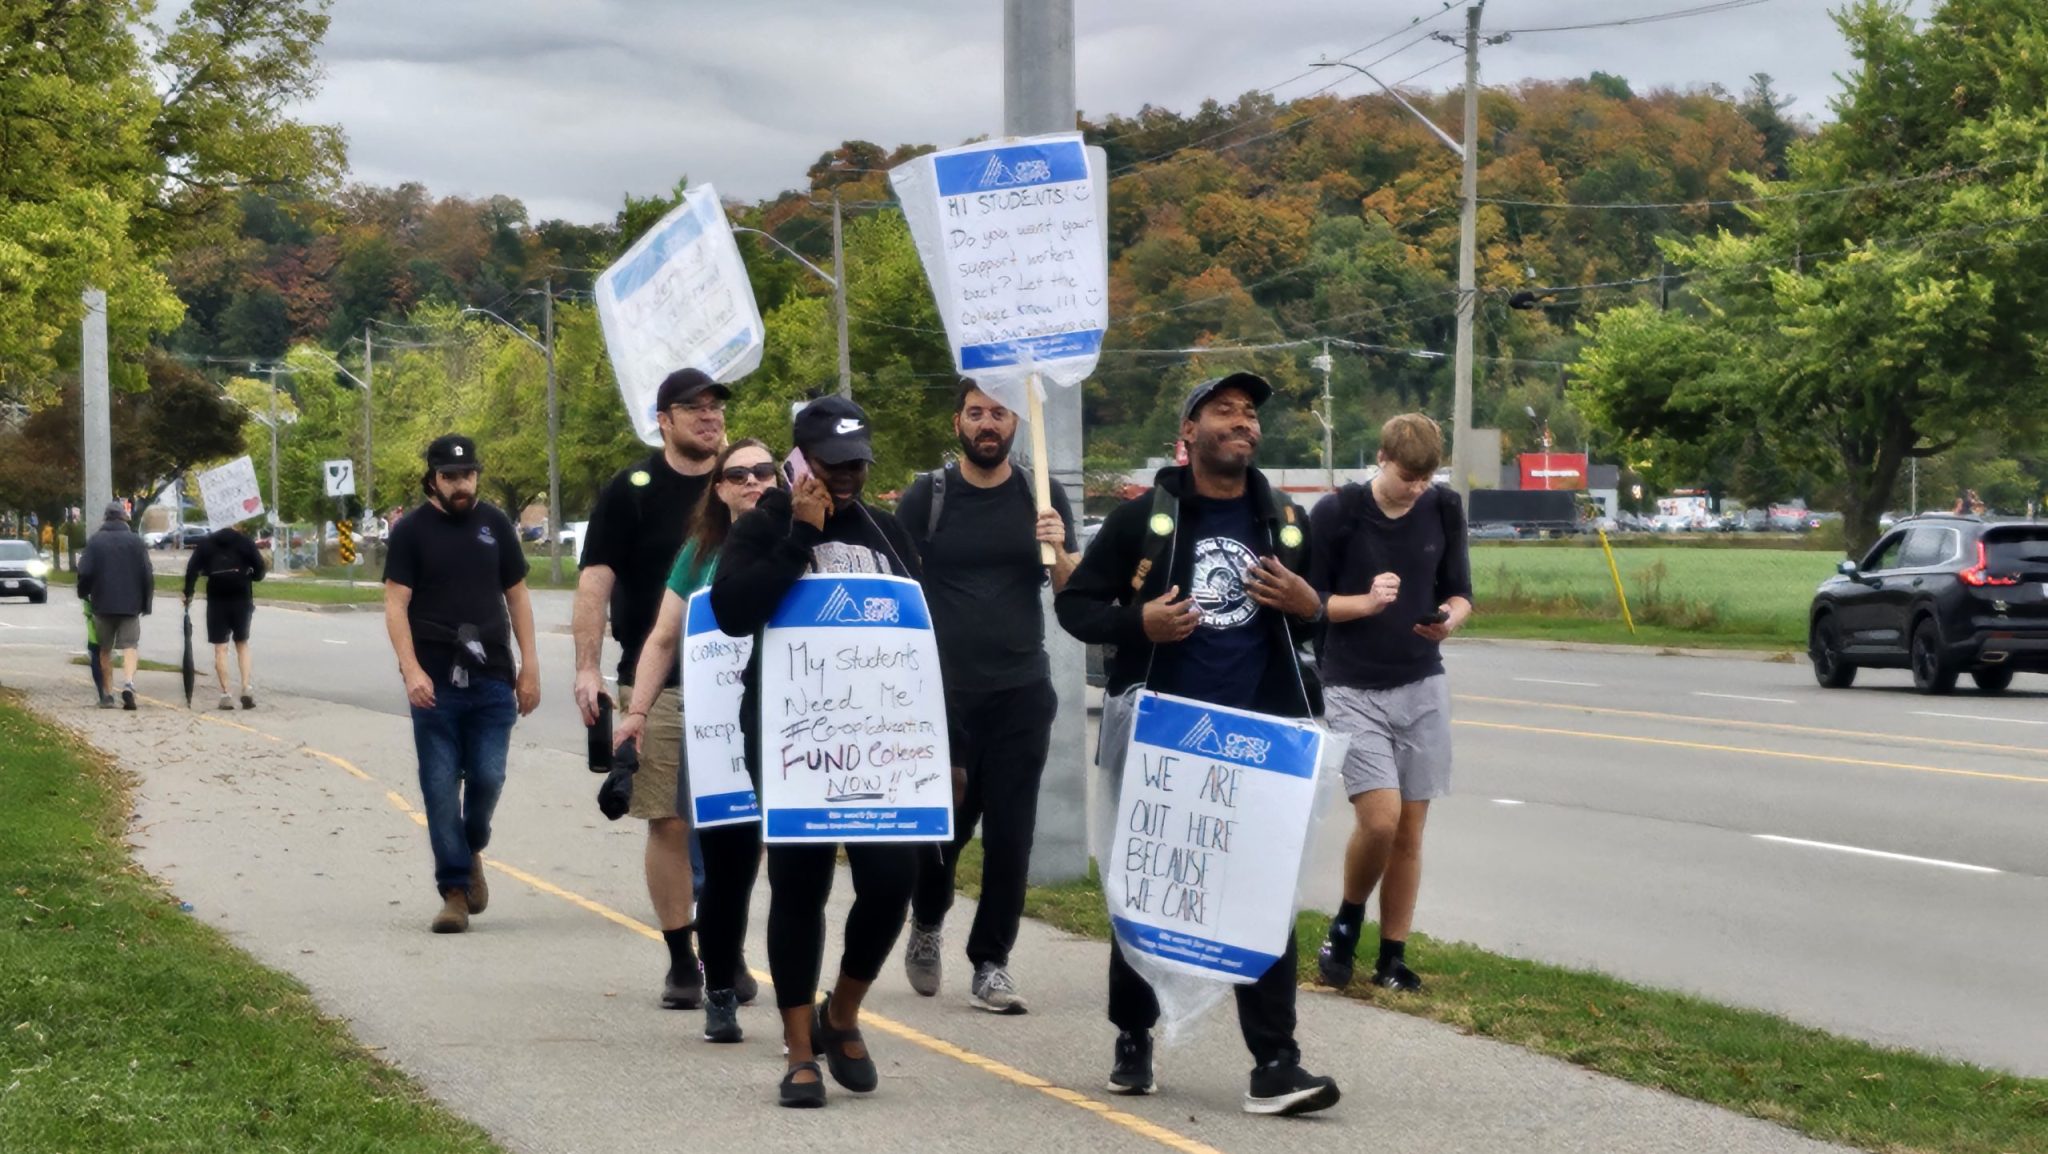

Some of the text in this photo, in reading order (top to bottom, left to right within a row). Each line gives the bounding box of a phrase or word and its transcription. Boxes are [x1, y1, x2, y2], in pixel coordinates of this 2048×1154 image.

[948, 198, 968, 217] HI
[951, 217, 1094, 249] Do you want your
[1051, 274, 1078, 290] the
[787, 641, 920, 695] My Students
[785, 685, 862, 716] Need
[780, 741, 936, 780] FUND Colleges
[1144, 753, 1243, 808] WE ARE
[1130, 799, 1239, 853] OUT HERE
[1125, 837, 1214, 889] BECAUSE
[1124, 875, 1215, 925] WE CARE
